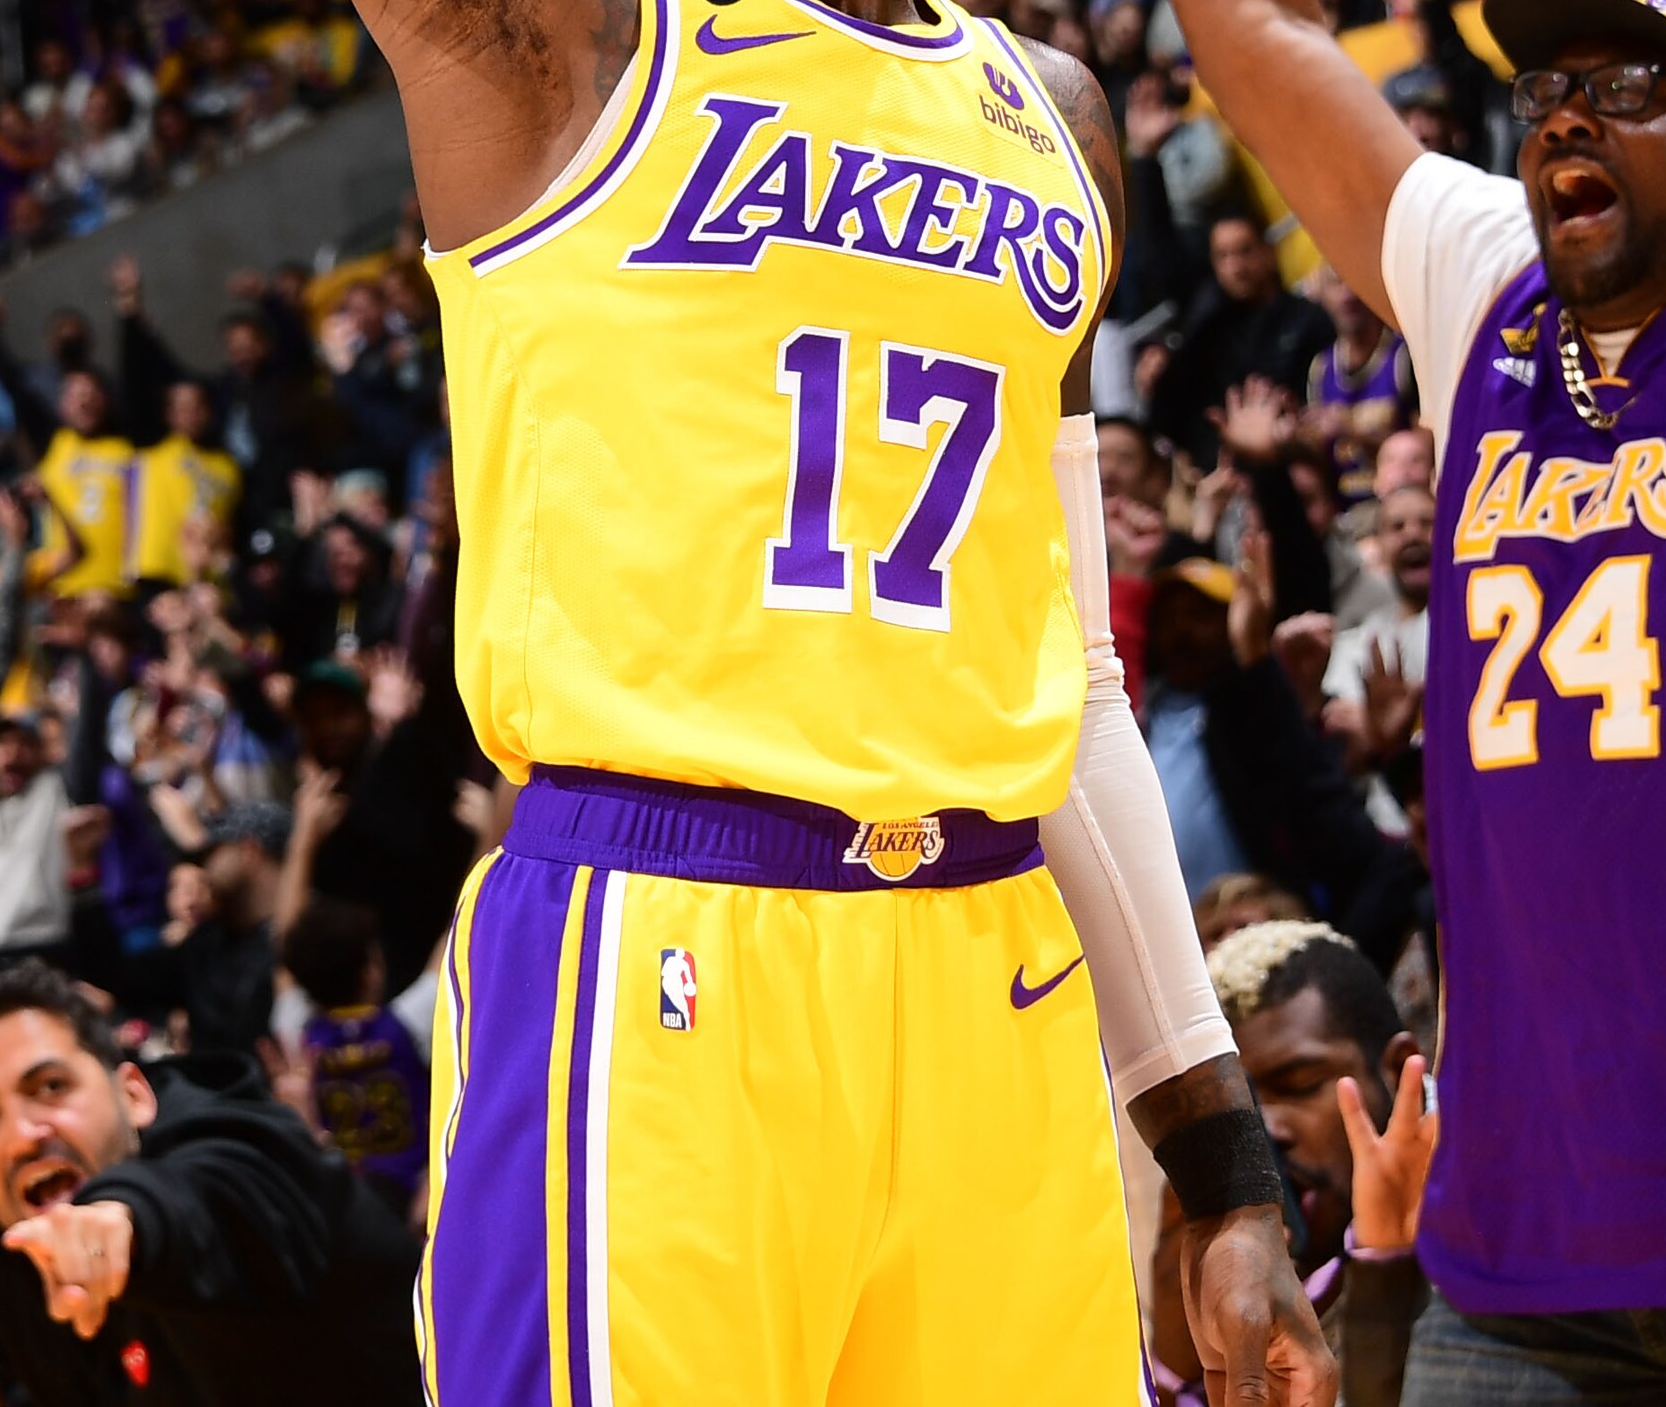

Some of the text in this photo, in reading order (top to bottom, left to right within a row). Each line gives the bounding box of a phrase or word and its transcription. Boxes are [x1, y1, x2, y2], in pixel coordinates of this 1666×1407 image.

[979, 94, 1056, 154] bibigo
[620, 95, 1085, 335] LAKERS
[762, 324, 1006, 633] 17
[1464, 554, 1662, 772] 24
[850, 823, 941, 859] LAKERS
[663, 1012, 682, 1028] NBA
